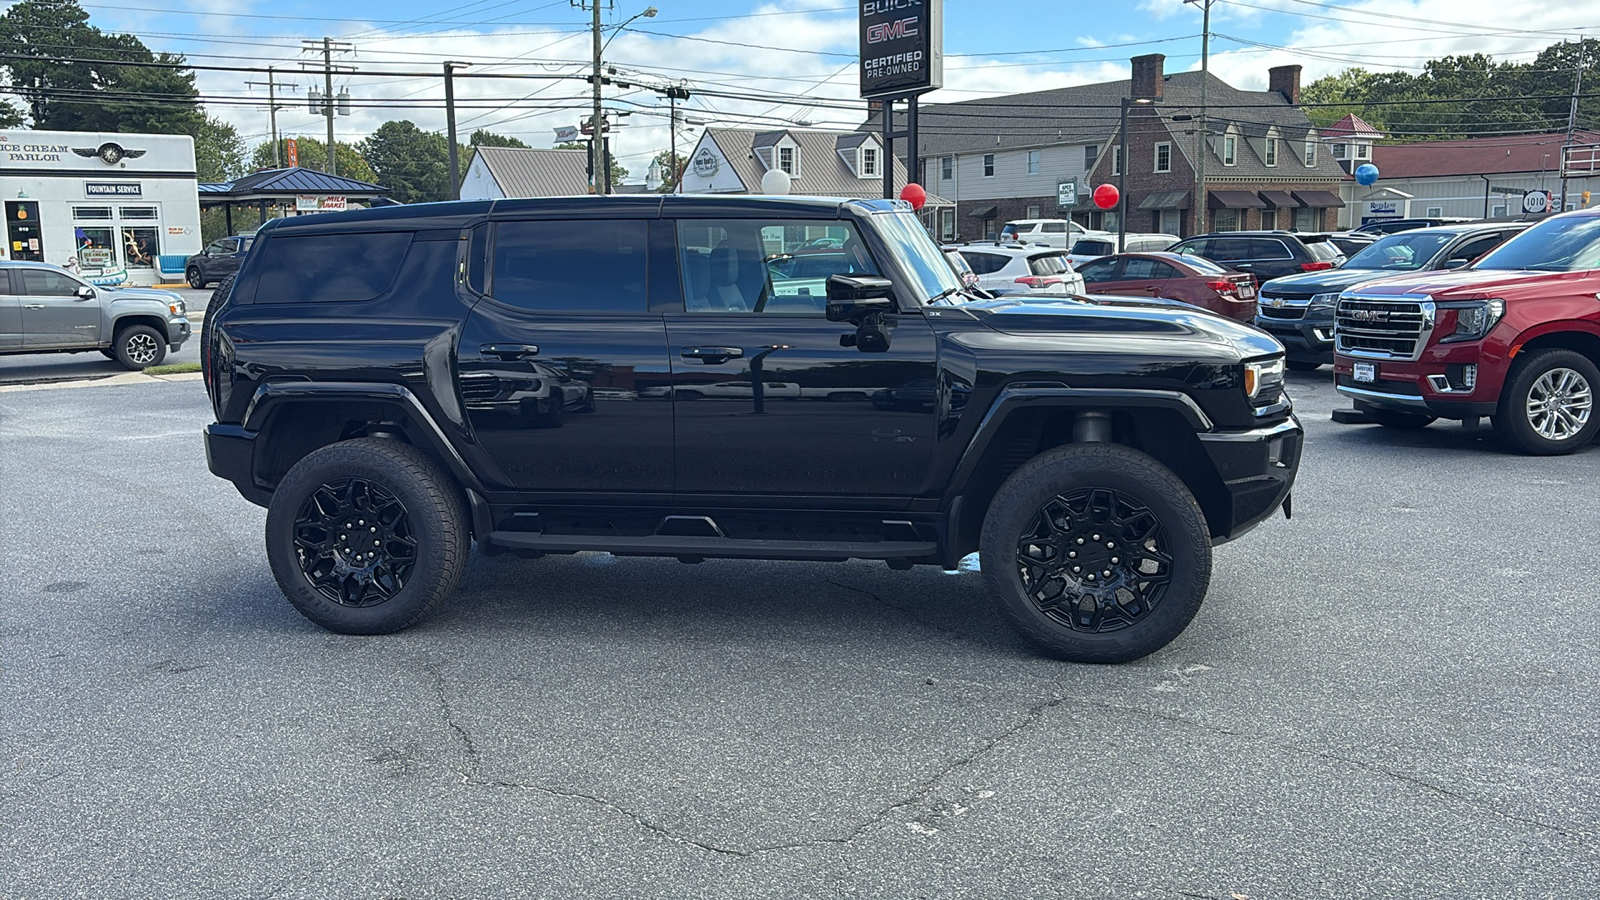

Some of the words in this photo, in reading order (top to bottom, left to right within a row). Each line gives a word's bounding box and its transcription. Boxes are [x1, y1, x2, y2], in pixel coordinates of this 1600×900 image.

[867, 16, 918, 44] GMC
[864, 50, 922, 70] CERTIFIED
[867, 61, 920, 79] PRE-OWNED
[0, 144, 20, 152] ICE
[23, 145, 69, 153] CREAM
[9, 153, 61, 161] PARLOR
[88, 185, 116, 194] FOUNTAIN
[117, 185, 140, 194] SERVICE
[1527, 197, 1544, 206] 1010
[1352, 310, 1389, 322] GMC
